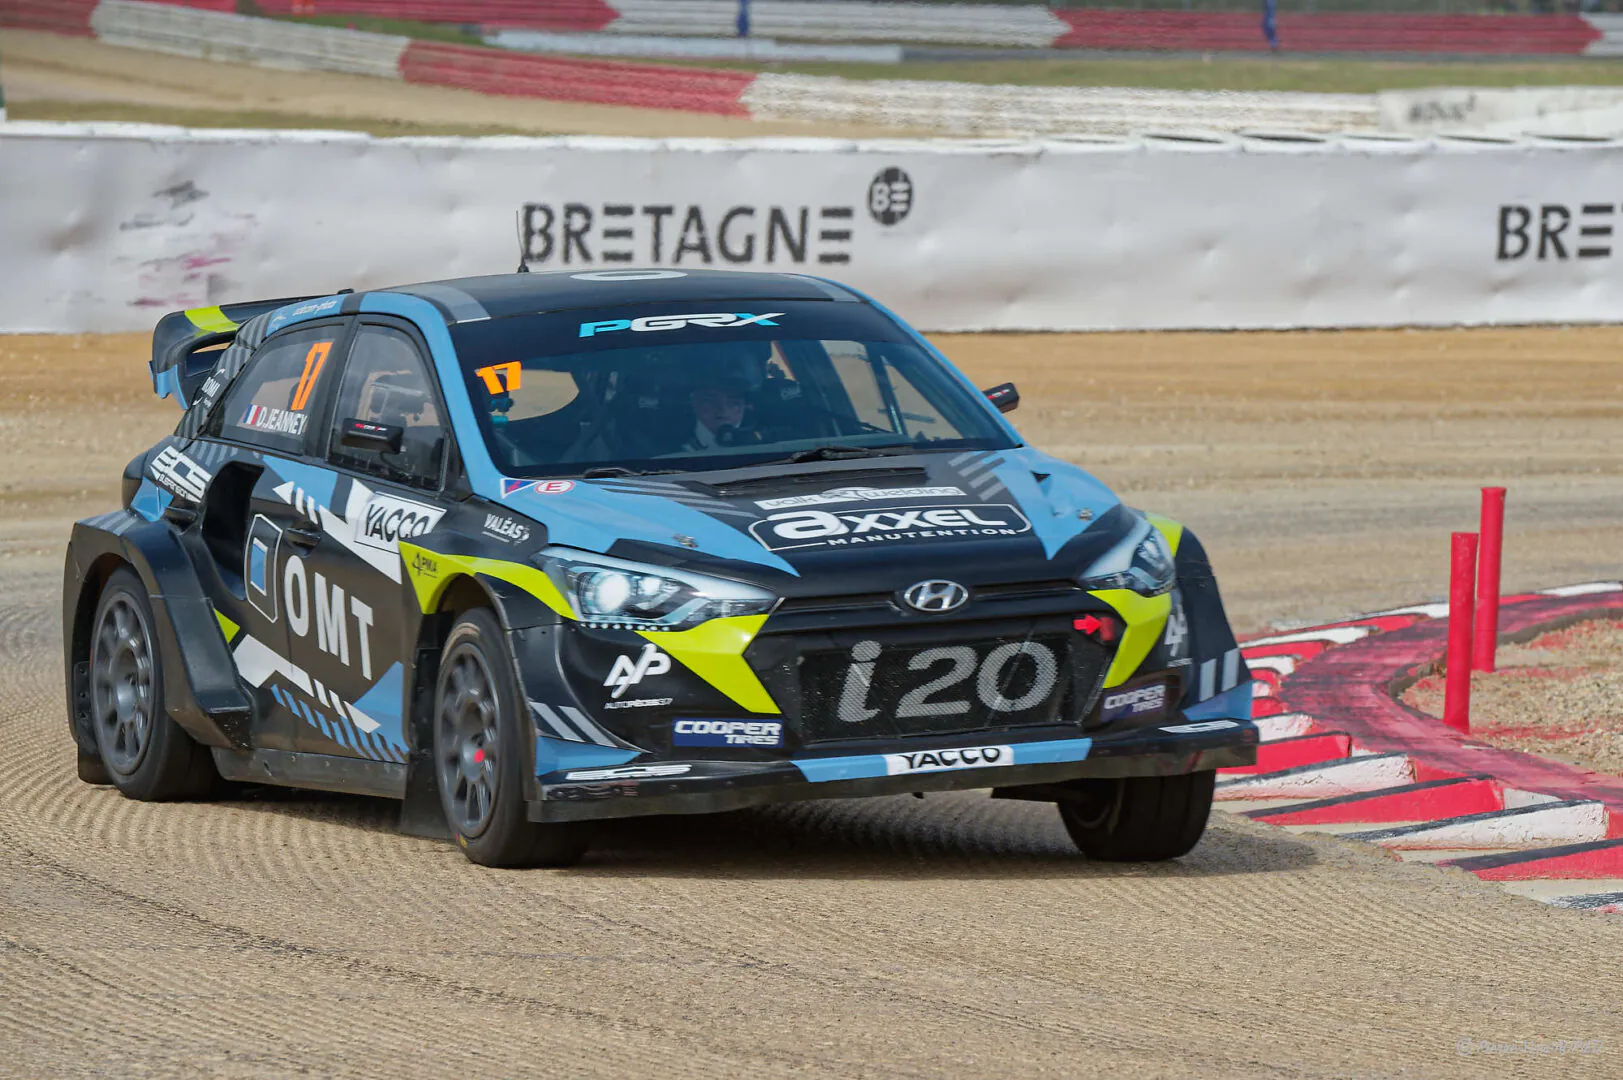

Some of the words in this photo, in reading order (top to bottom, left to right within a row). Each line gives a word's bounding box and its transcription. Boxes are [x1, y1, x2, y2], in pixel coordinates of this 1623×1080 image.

[522, 203, 853, 263] BRETAGNE
[1496, 203, 1623, 262] BRE
[579, 313, 786, 338] PGRX
[290, 341, 334, 411] 17
[475, 361, 522, 395] 17
[364, 503, 430, 543] YACCO
[829, 528, 1017, 546] MANUTENTION
[284, 555, 374, 680] OMT
[1103, 684, 1167, 710] COOPER
[674, 720, 782, 735] COOPER
[725, 734, 779, 745] TIRES
[897, 746, 1001, 769] YACCO
